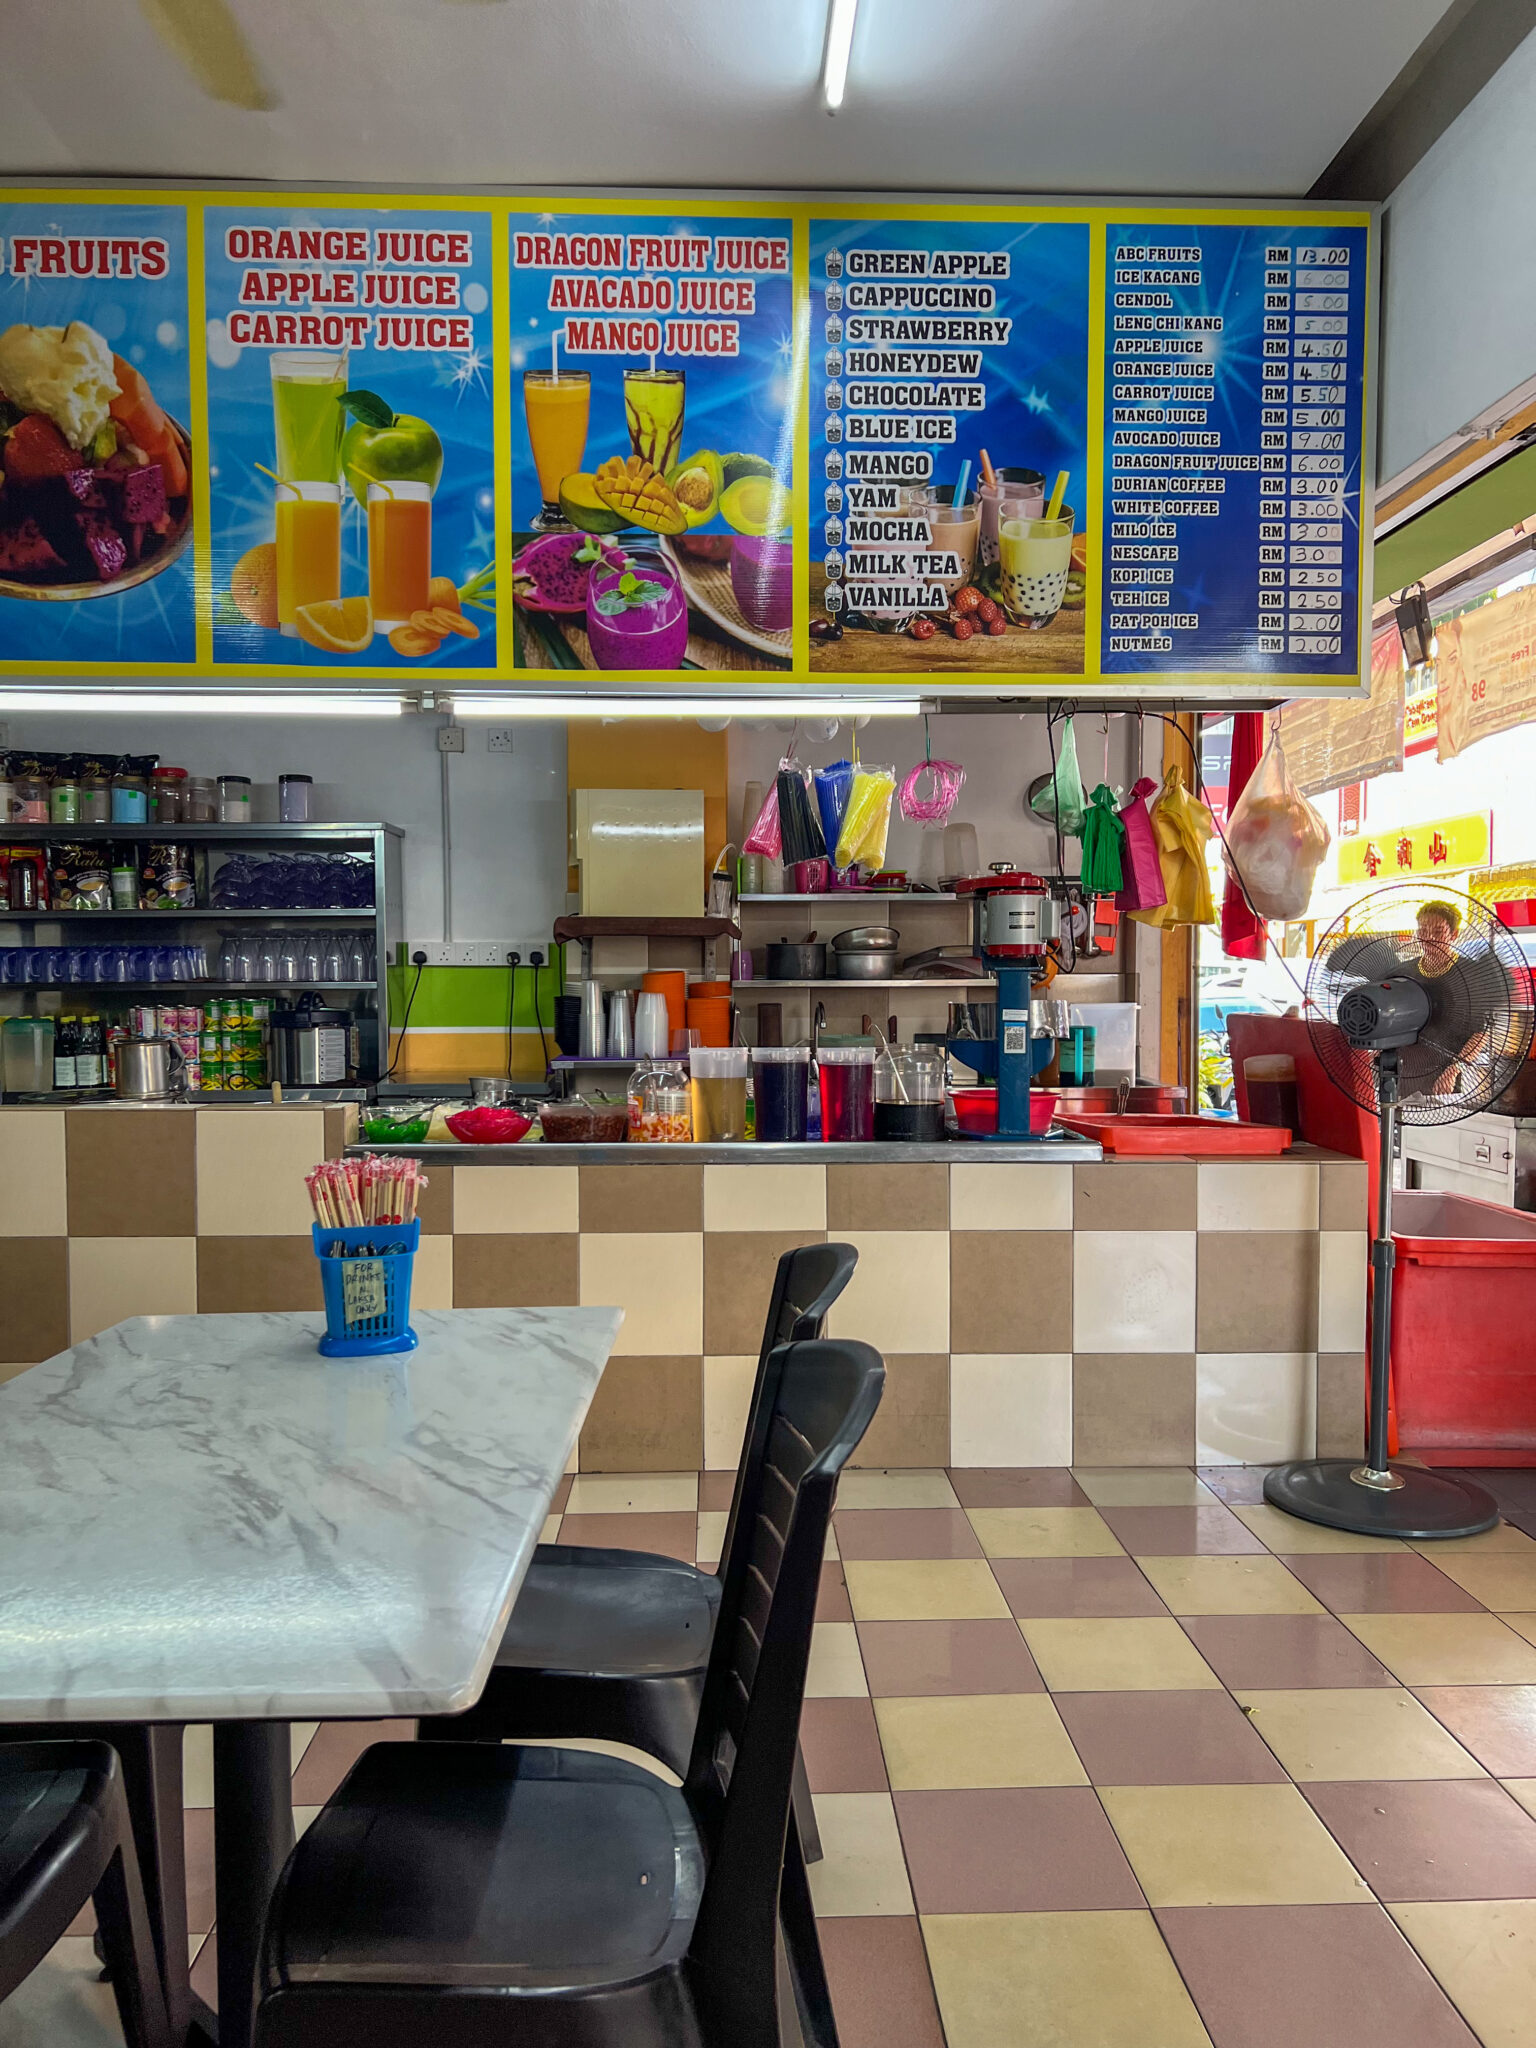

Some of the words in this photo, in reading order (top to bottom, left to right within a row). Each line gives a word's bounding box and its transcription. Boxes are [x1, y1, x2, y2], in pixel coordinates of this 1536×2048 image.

[228, 229, 367, 260] ORANGE
[376, 232, 469, 263] JUICE
[515, 236, 622, 268] DRAGON
[629, 238, 709, 269] FRUIT
[716, 240, 787, 270] JUICE
[13, 239, 165, 276] FRUITS
[1116, 248, 1145, 261] ABC
[1148, 248, 1201, 261] FRUITS
[1268, 249, 1289, 262] RM
[1301, 249, 1348, 263] 13.00
[849, 253, 926, 274] GREEN
[932, 255, 1007, 276] APPLE
[1116, 270, 1140, 283] ICE
[1143, 271, 1200, 284] KACANG
[1267, 272, 1289, 285] RM
[242, 272, 355, 303] APPLE
[364, 274, 457, 305] JUICE
[550, 279, 672, 310] AVACADO
[679, 282, 753, 311] JUICE
[849, 286, 992, 308] CAPPUCCINO
[1115, 293, 1172, 307] CENDOL
[1266, 295, 1288, 308] RM
[230, 314, 368, 346] CARROT
[378, 317, 470, 348] JUICE
[849, 319, 1009, 342] STRAWBERRY
[1115, 317, 1152, 330] LENG
[1155, 317, 1180, 330] CHI
[1184, 317, 1222, 330] KANG
[1266, 318, 1287, 331] RM
[567, 321, 659, 351] MANGO
[666, 323, 737, 353] JUICE
[1114, 340, 1161, 353] APPLE
[1164, 341, 1204, 353] JUICE
[1265, 342, 1287, 354] RM
[1301, 342, 1344, 357] 4.50
[849, 352, 979, 374] HONEYDEW
[1114, 363, 1171, 376] ORANGE
[1174, 364, 1214, 376] JUICE
[1265, 365, 1286, 377] RM
[1300, 363, 1341, 380] 4.50
[849, 385, 982, 407] CHOCOLATE
[1114, 386, 1171, 399] CARROT
[1174, 386, 1213, 399] JUICE
[1264, 388, 1286, 400] RM
[1300, 386, 1339, 403] 5.50
[1114, 409, 1164, 422] MANGO
[1167, 409, 1206, 423] JUICE
[1264, 411, 1285, 424] RM
[1295, 409, 1340, 426] 5.00
[849, 418, 910, 439] BLUE
[915, 419, 953, 439] ICE
[1114, 432, 1177, 445] AVOCADO
[1180, 433, 1219, 446] JUICE
[1263, 434, 1285, 446] RM
[1298, 432, 1343, 449] 9.00
[849, 455, 929, 476] MANGO
[1114, 454, 1171, 468] DRAGON
[1174, 455, 1217, 469] FRUIT
[1219, 456, 1258, 469] JUICE
[1263, 456, 1284, 469] RM
[1298, 456, 1340, 470] 6.00
[1113, 478, 1167, 491] DURIAN
[1170, 478, 1224, 491] COFFEE
[1262, 480, 1284, 492] RM
[1296, 479, 1338, 494] 3.00
[849, 488, 897, 508] YAM
[1113, 501, 1161, 514] WHITE
[1164, 501, 1218, 514] COFFEE
[1262, 503, 1284, 515] RM
[1298, 503, 1338, 517] 3.00
[849, 521, 929, 541] MOCHA
[1113, 524, 1148, 537] MILO
[1151, 524, 1175, 537] ICE
[1262, 525, 1283, 538] RM
[1112, 547, 1177, 559] NESCAFE
[1262, 548, 1283, 561] RM
[849, 554, 906, 574] MILK
[912, 555, 959, 575] TEA
[1112, 570, 1145, 582] KOPI
[1148, 570, 1173, 583] ICE
[1261, 571, 1283, 584] RM
[1298, 572, 1338, 584] 2.50
[848, 587, 945, 608] VANILLA
[1112, 592, 1141, 605] TEH
[1144, 593, 1168, 605] ICE
[1261, 593, 1283, 606] RM
[1298, 593, 1338, 607] 2.50
[1111, 615, 1139, 627] PAT
[1142, 615, 1171, 628] POH
[1173, 615, 1198, 628] ICE
[1261, 616, 1282, 628] RM
[1293, 614, 1340, 631] 2.00
[1110, 638, 1171, 650] NUTMEG
[1261, 638, 1282, 651] RM
[1294, 637, 1339, 653] 2.00
[354, 1263, 373, 1274] FOR
